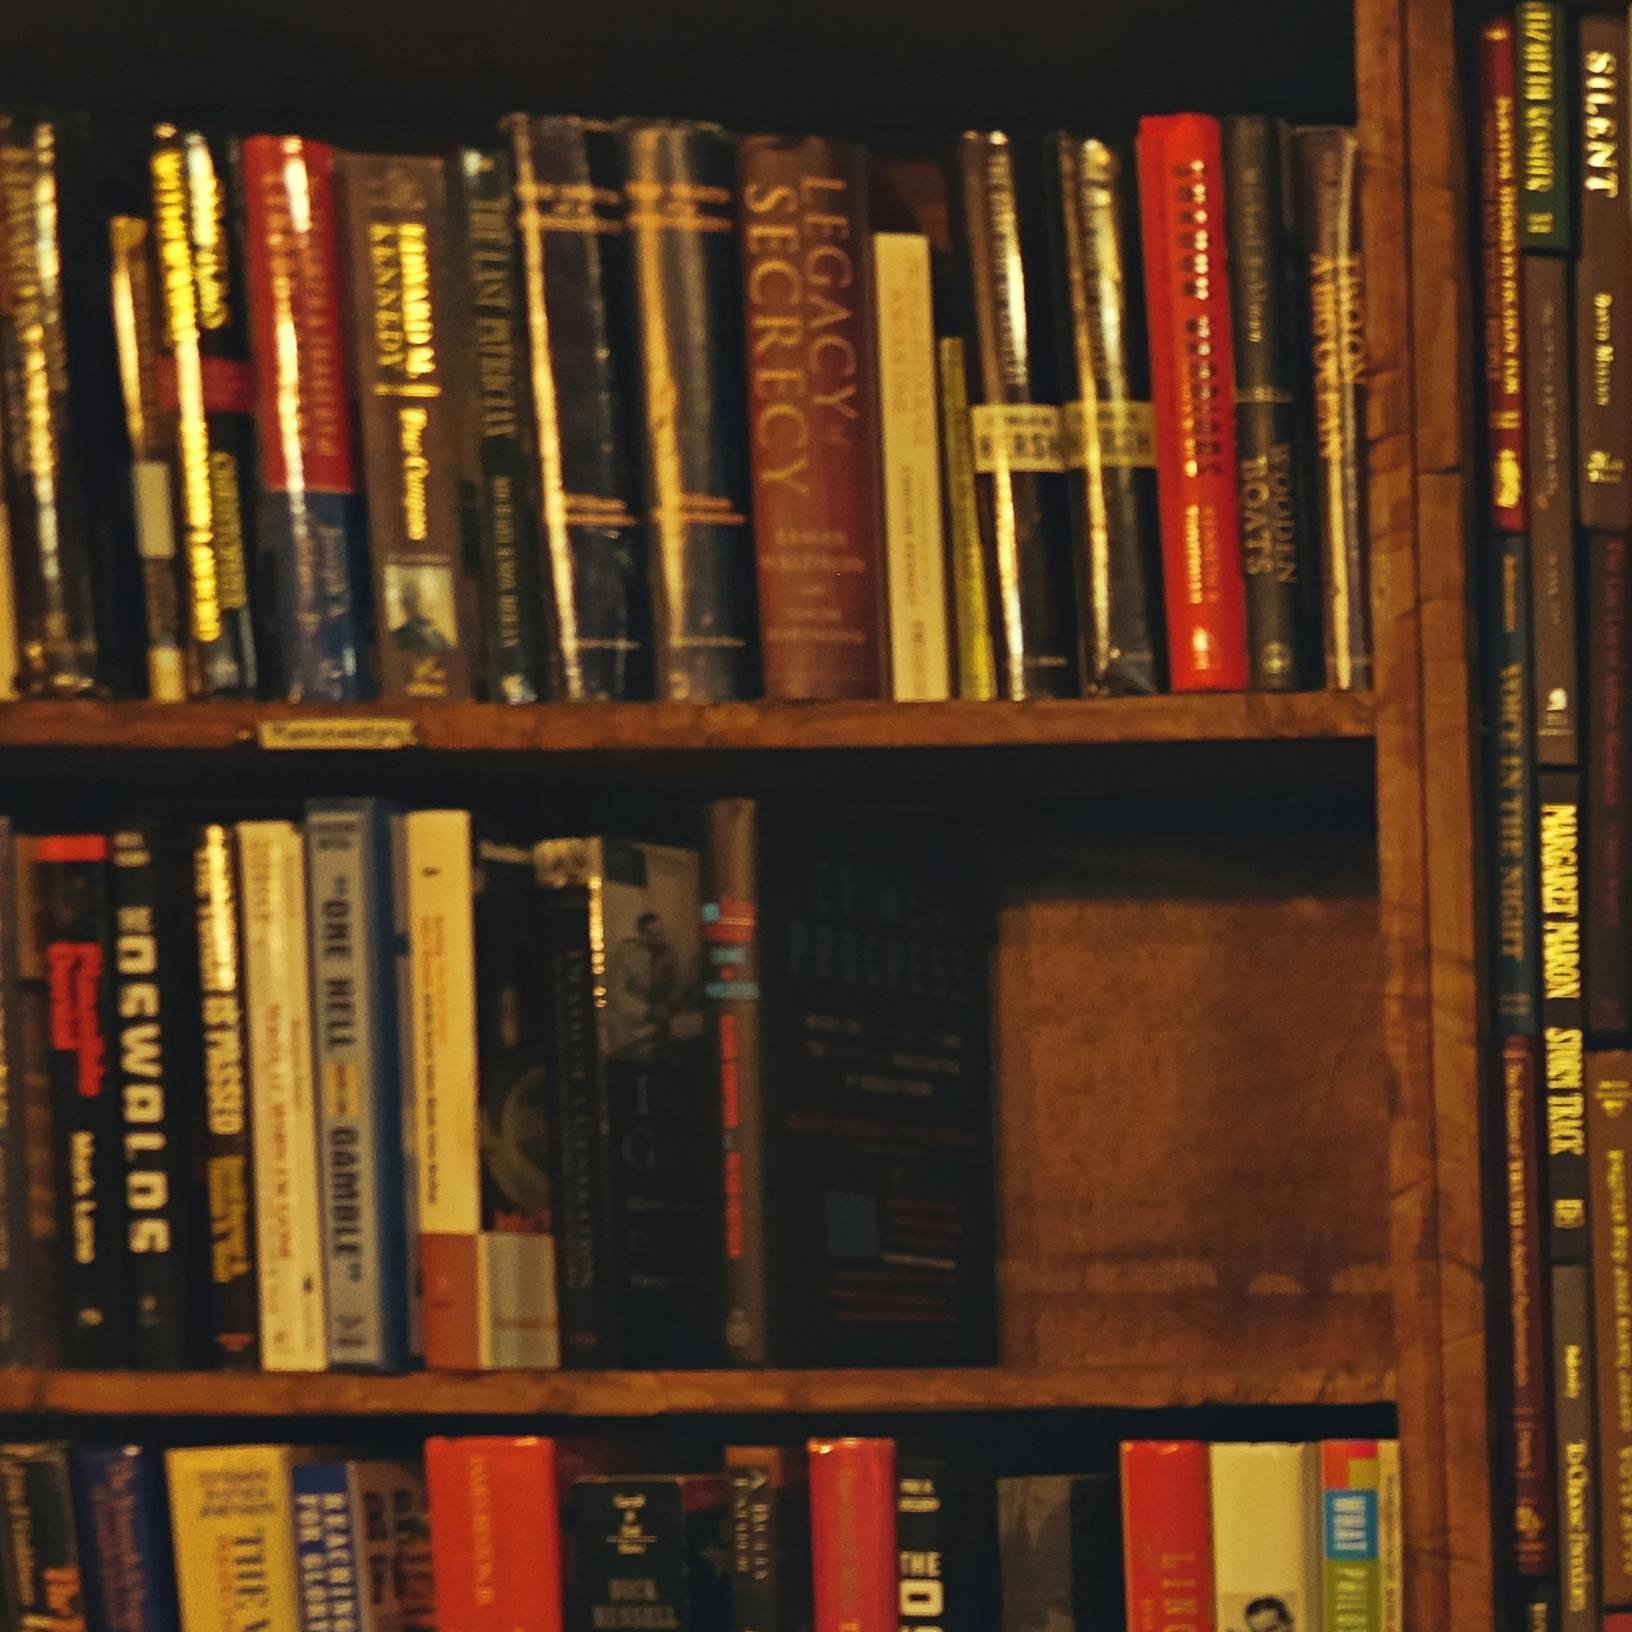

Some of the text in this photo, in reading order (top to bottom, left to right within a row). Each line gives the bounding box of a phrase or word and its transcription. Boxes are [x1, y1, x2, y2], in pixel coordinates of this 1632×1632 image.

[1585, 50, 1619, 198] SILENT
[369, 224, 405, 388] KENNEDY
[745, 183, 814, 497] SECRECY
[803, 177, 859, 419] LEGACY
[1241, 456, 1272, 575] BOATS
[1272, 444, 1297, 584] WOODEN
[1540, 805, 1582, 998] MARGARET MARON
[327, 974, 354, 1048] HELL
[117, 934, 170, 1253] OSWALDS
[1545, 1028, 1585, 1155] STORM TRACK
[70, 1132, 97, 1264] Mark Lane
[234, 1529, 268, 1602] THE
[1334, 1495, 1368, 1553] WHAT
